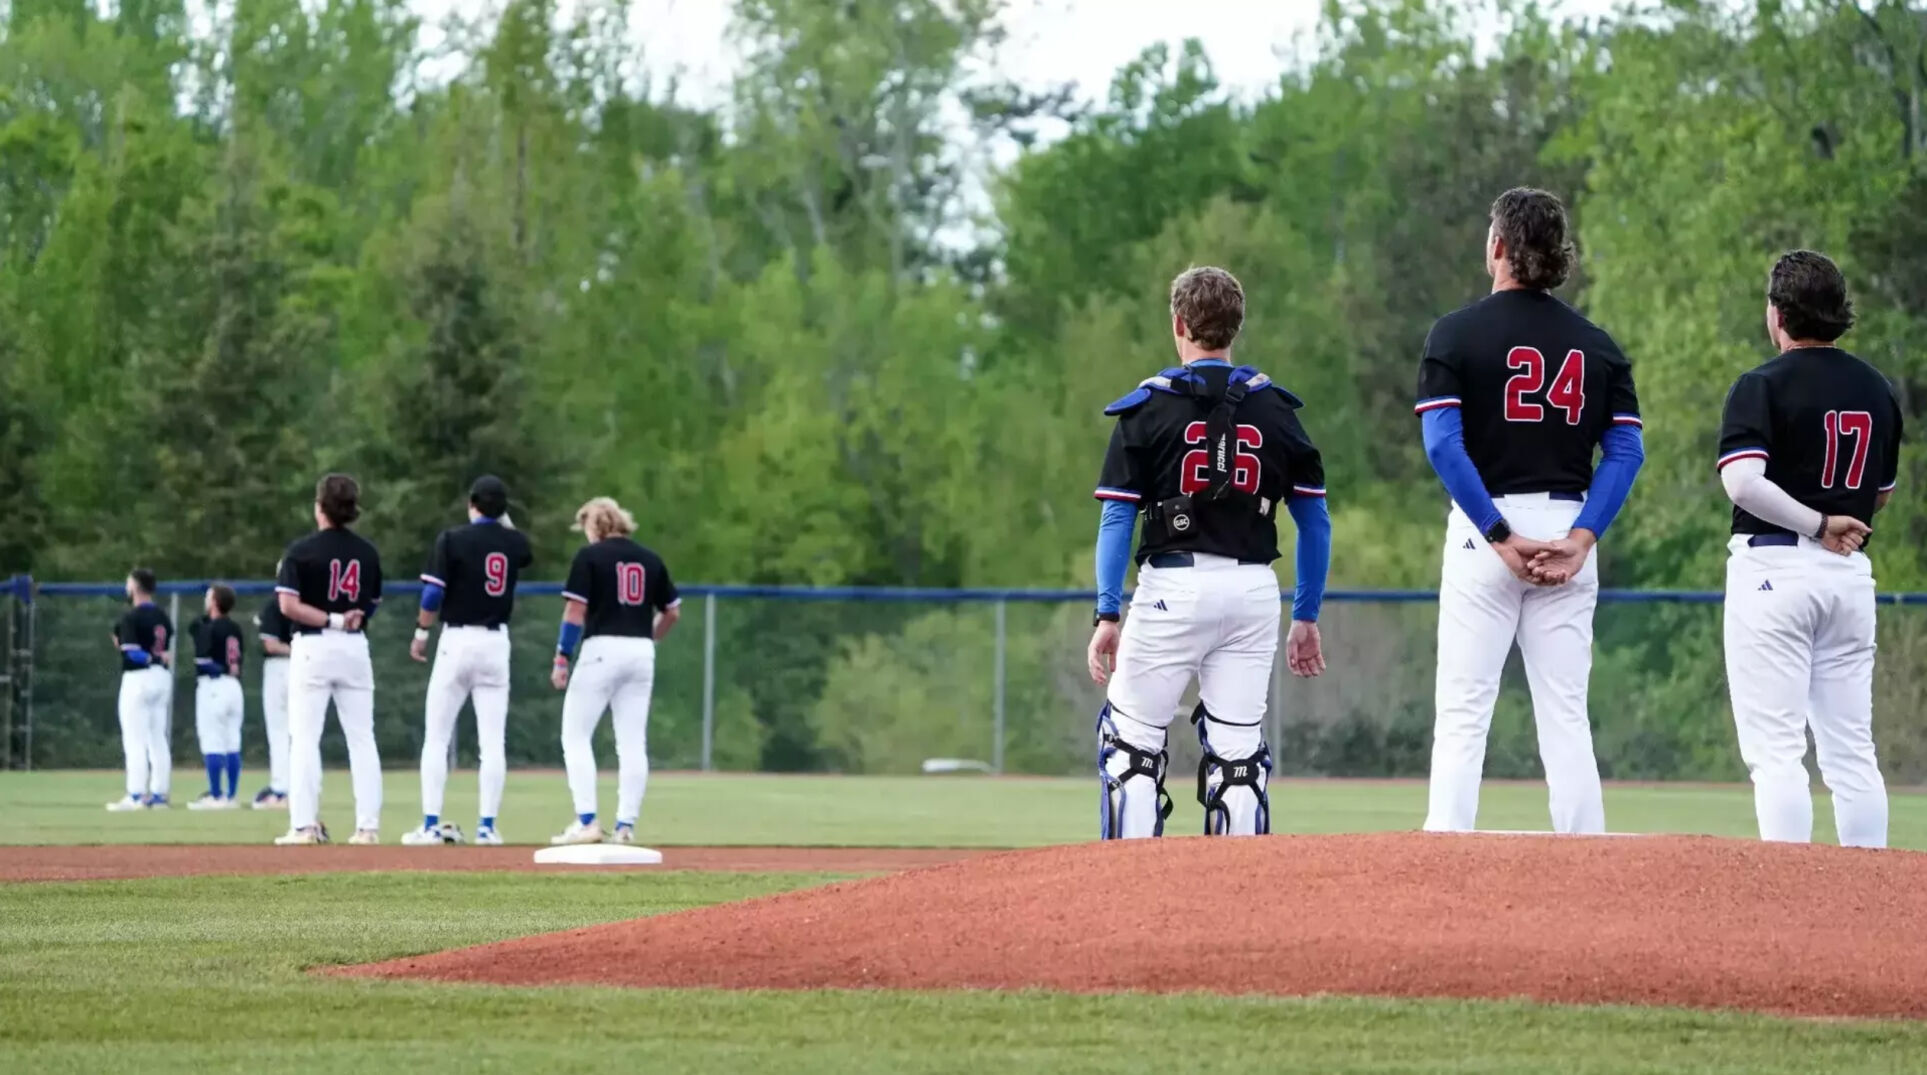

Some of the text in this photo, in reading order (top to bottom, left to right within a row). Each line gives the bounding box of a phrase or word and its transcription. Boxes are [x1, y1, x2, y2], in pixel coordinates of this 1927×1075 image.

[1504, 346, 1585, 425] 24
[1180, 421, 1262, 495] 26
[1821, 410, 1873, 489] 17
[329, 558, 361, 602] 14
[485, 552, 508, 596] 9
[616, 561, 646, 605] 10
